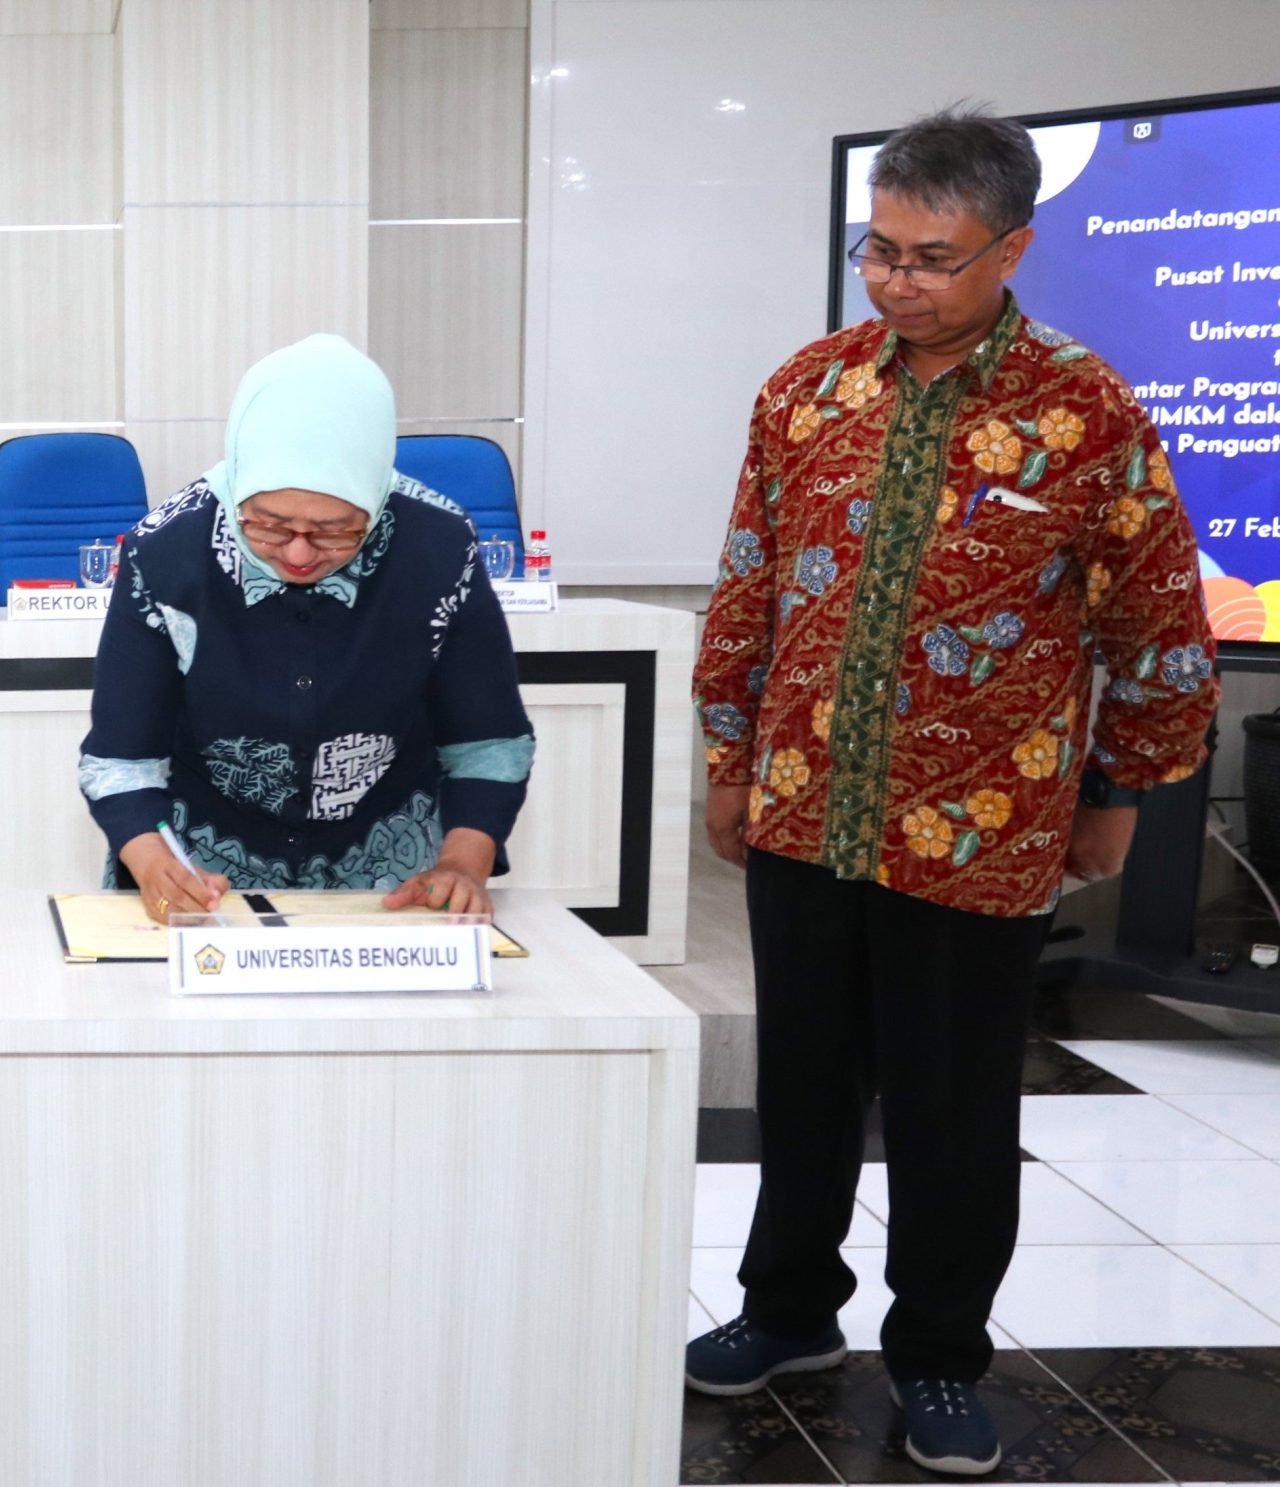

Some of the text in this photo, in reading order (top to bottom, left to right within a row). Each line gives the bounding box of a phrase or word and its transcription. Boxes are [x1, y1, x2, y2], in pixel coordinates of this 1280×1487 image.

[1087, 208, 1280, 236] Penandatangan
[1154, 265, 1224, 287] Pusat
[1189, 320, 1280, 341] Univers
[1131, 376, 1280, 401] ntar Progra
[1208, 518, 1237, 538] 27
[29, 596, 97, 610] REKTOR
[236, 946, 458, 969] UNIVERSITAS BENGKULU
